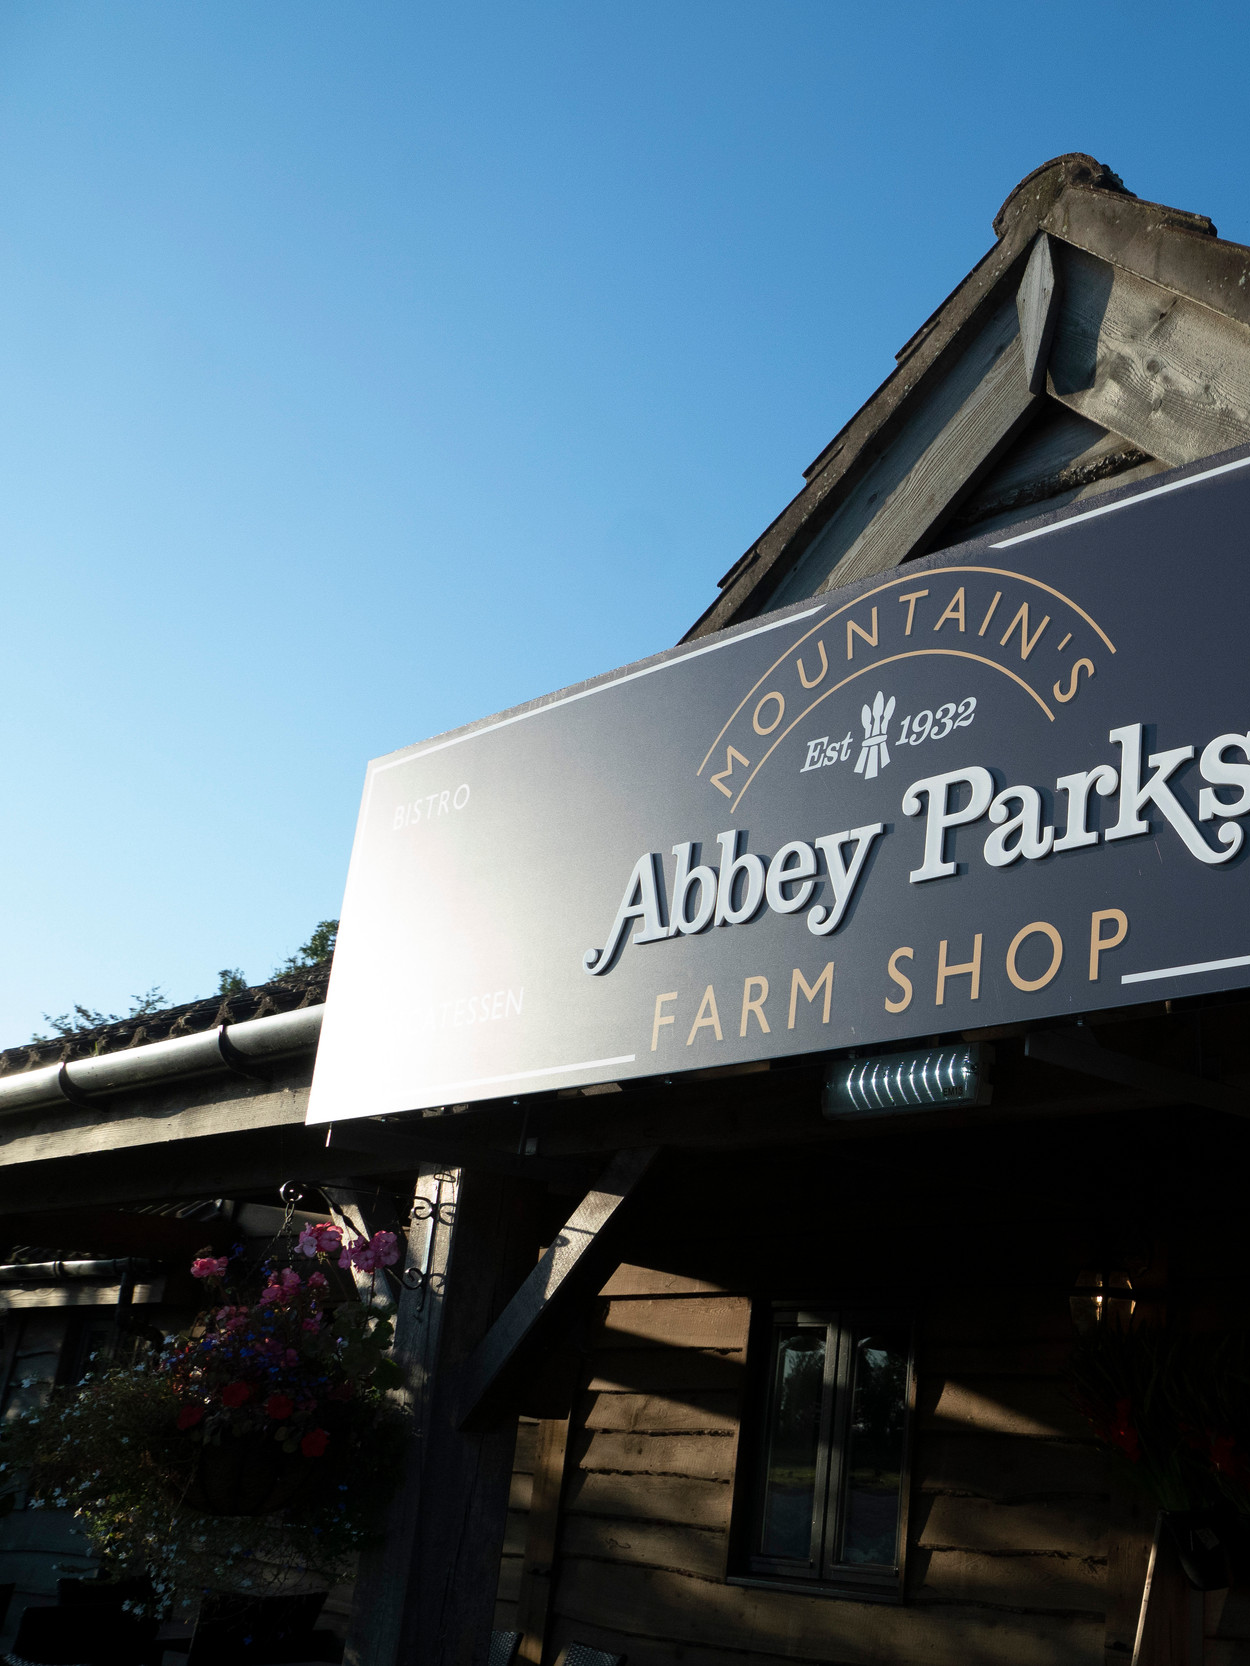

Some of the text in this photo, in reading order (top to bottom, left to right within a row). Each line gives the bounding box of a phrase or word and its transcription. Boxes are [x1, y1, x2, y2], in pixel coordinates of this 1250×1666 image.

[709, 588, 1095, 799] MOUNTAIN'S
[801, 696, 978, 774] Est 1932
[393, 783, 471, 830] BISTRO
[583, 822, 883, 976] Abbey
[650, 908, 1129, 1052] FARM SHOP
[943, 1086, 963, 1096] EM13
